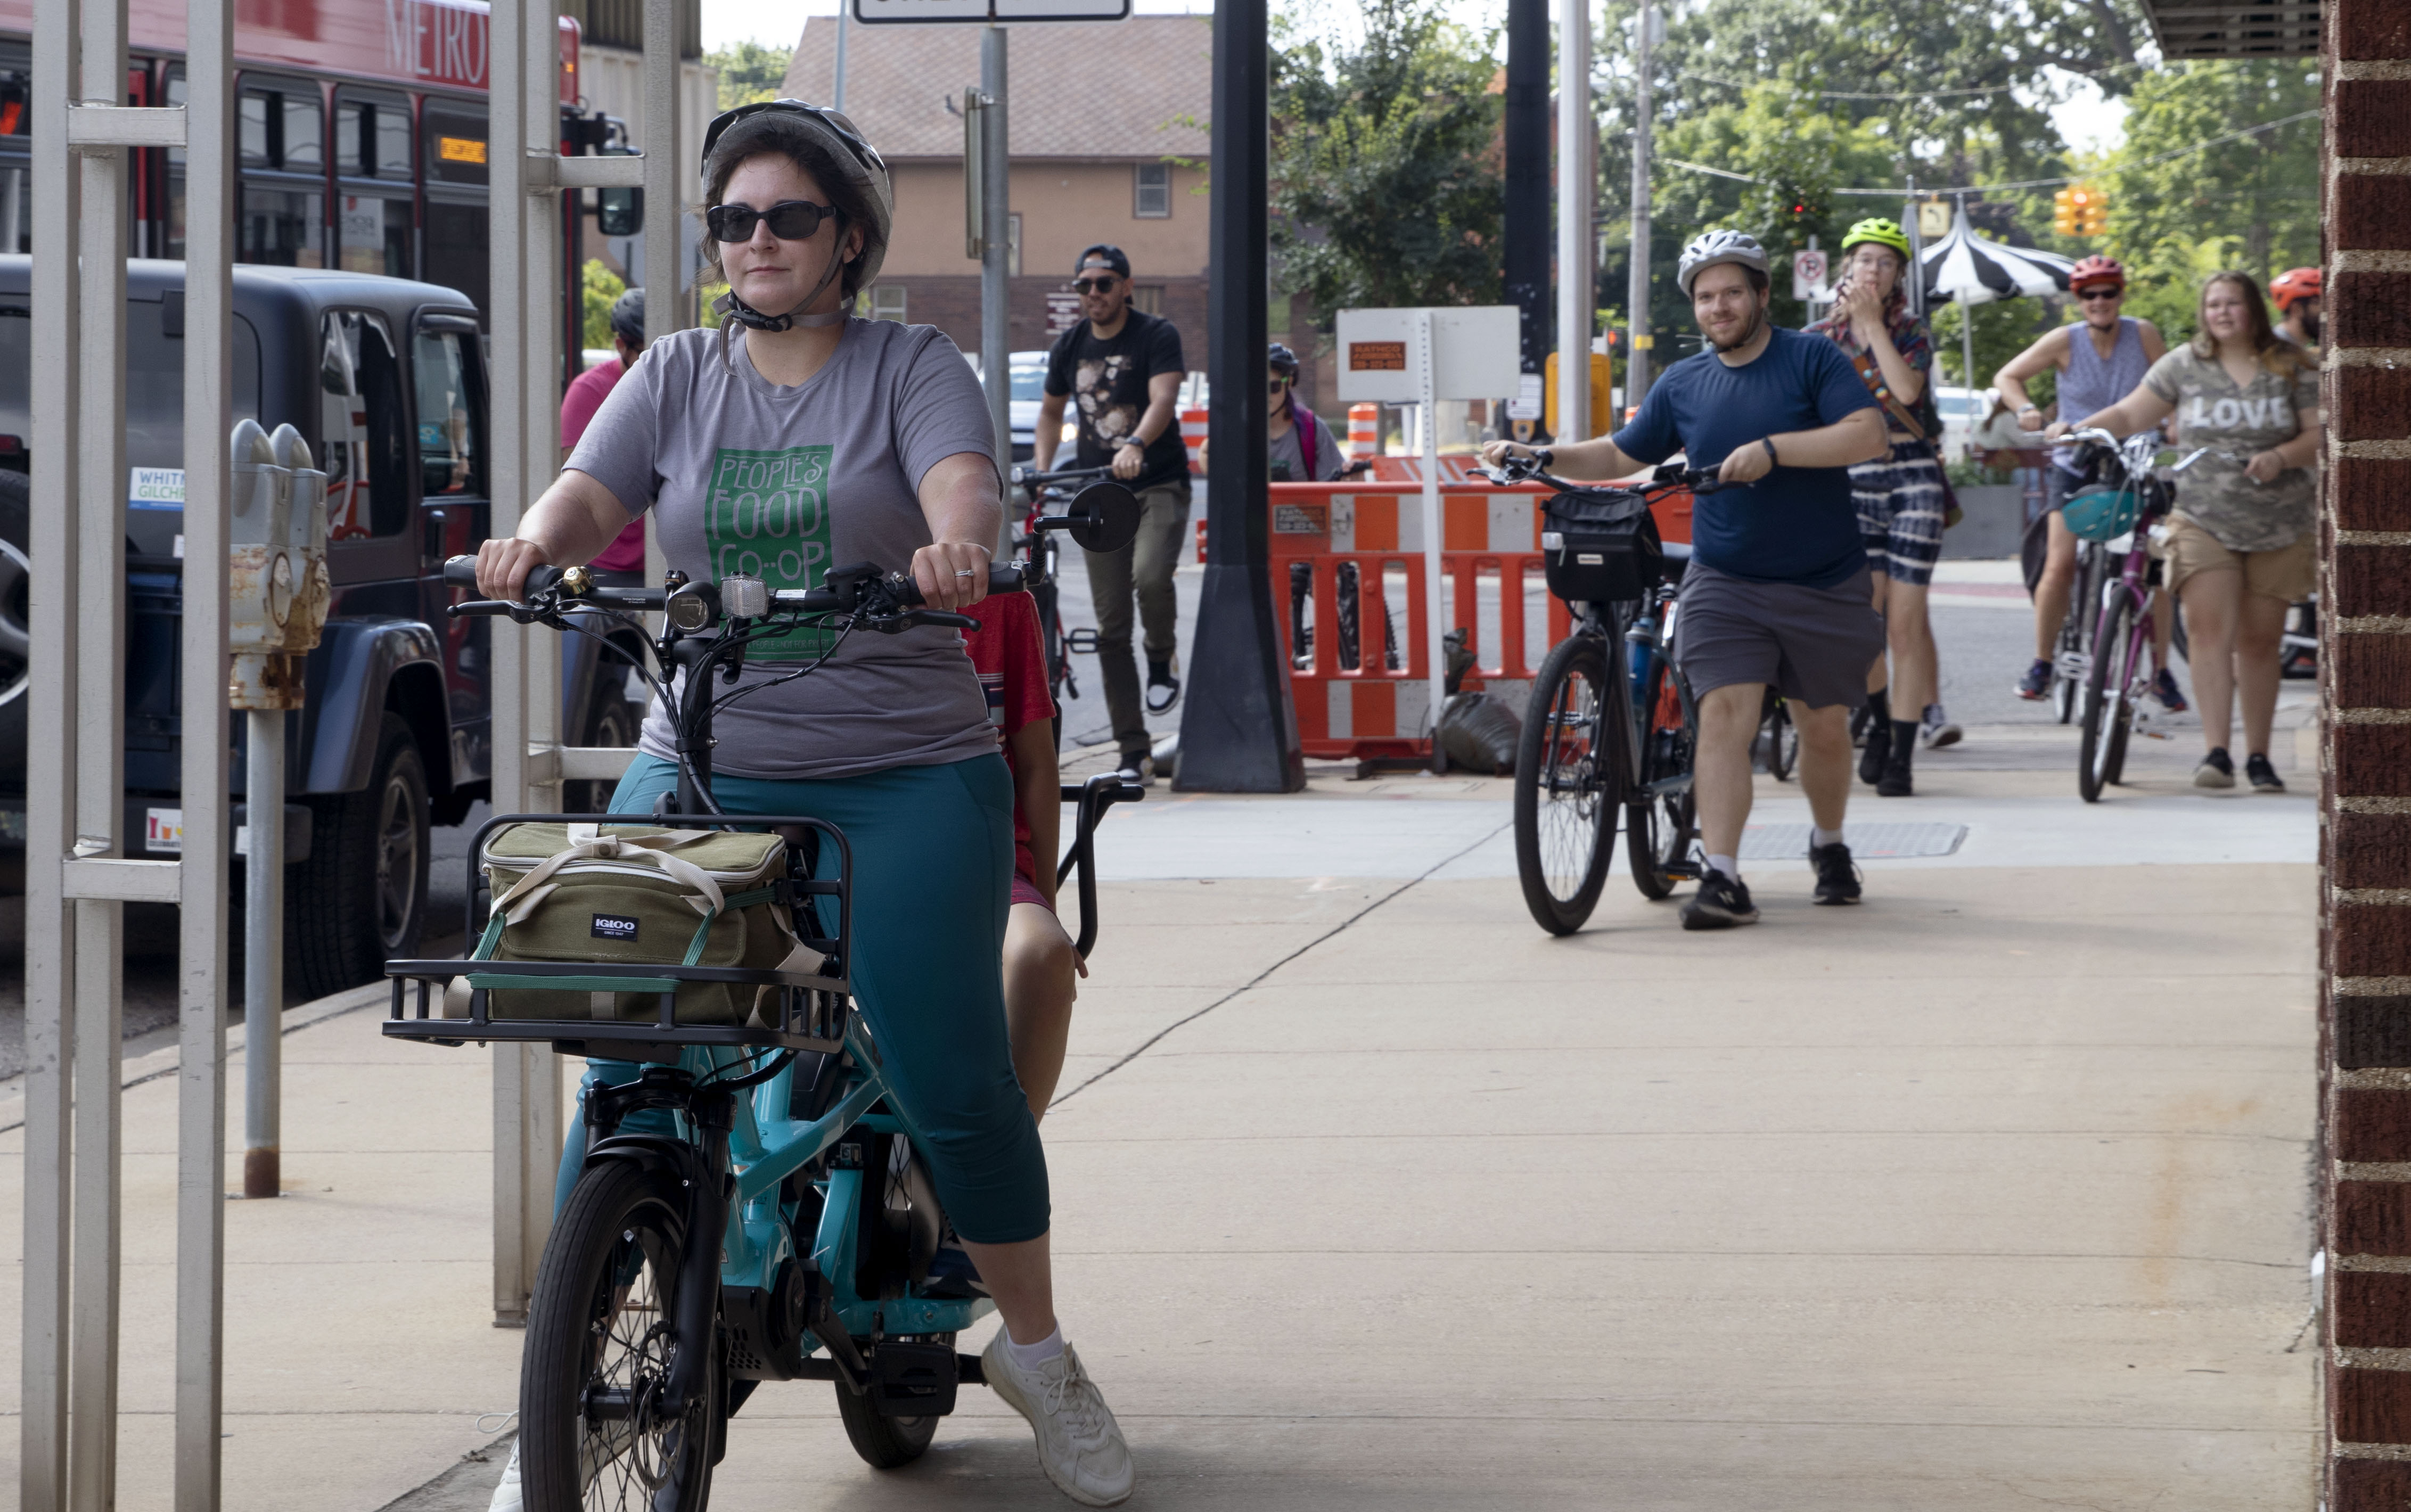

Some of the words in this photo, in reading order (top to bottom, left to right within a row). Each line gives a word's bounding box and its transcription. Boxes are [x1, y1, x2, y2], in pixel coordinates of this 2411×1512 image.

[2192, 396, 2291, 429] LOVE
[717, 454, 823, 489] PEOPLE'S
[711, 487, 822, 539] FOOD
[752, 640, 775, 650] PEOPLE
[794, 640, 806, 648] FOR
[596, 918, 635, 930] IGLOO
